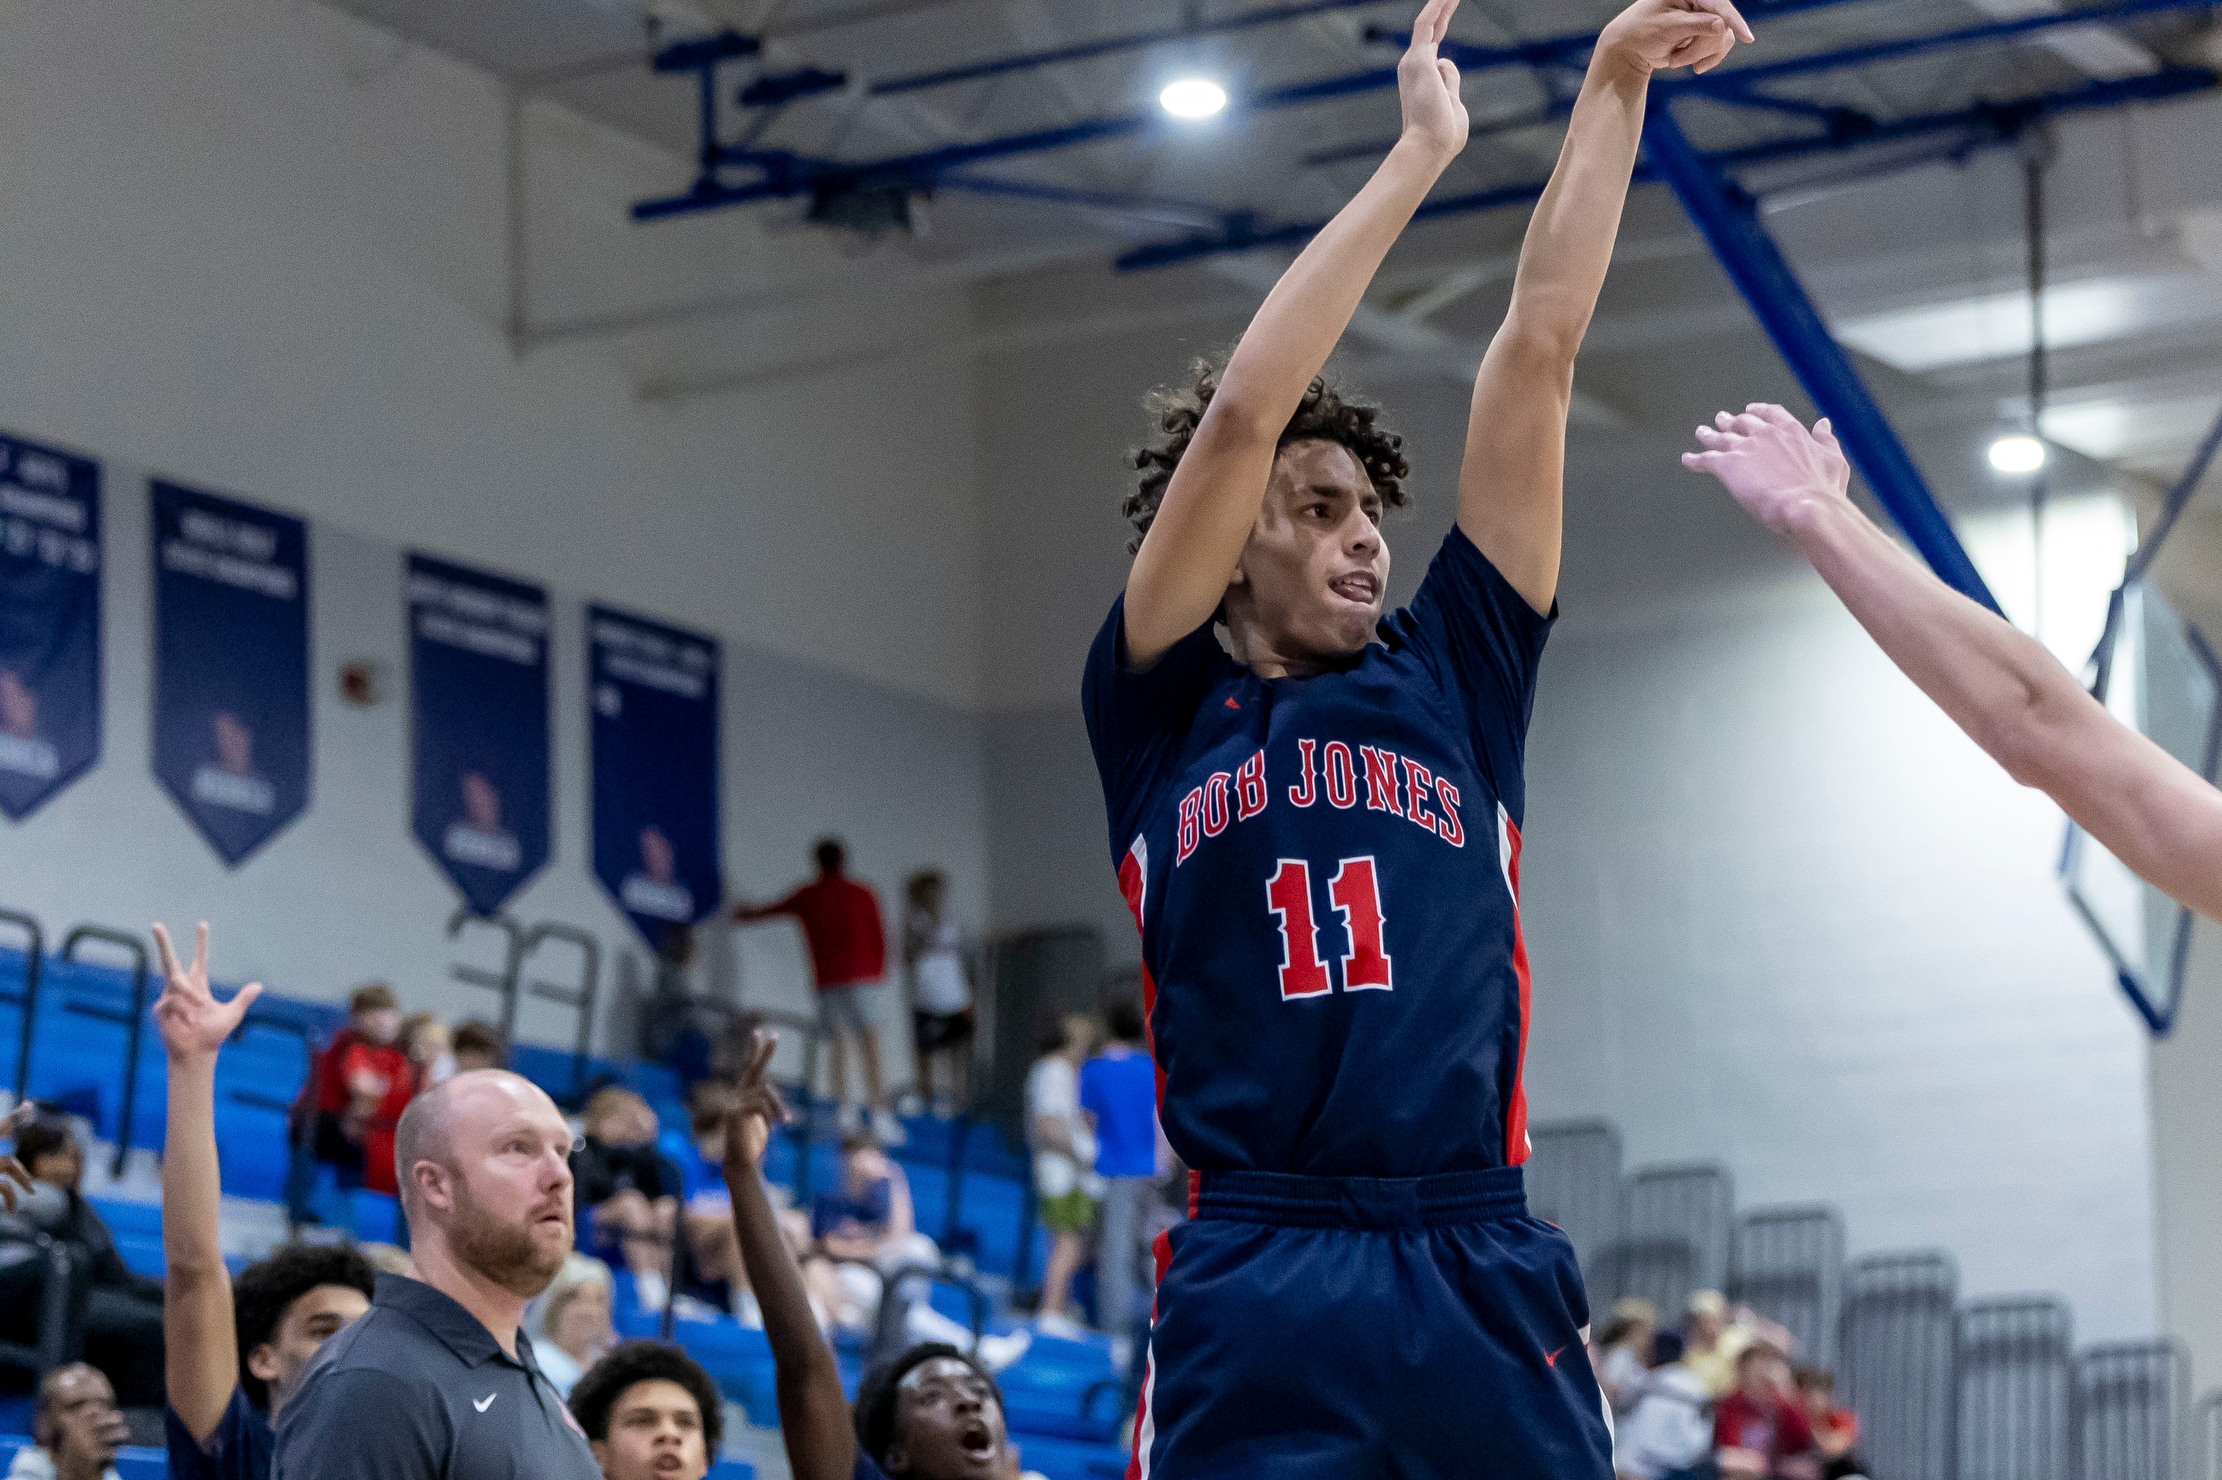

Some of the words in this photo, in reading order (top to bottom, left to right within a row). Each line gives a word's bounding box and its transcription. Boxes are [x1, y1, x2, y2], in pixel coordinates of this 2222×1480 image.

[1176, 749, 1268, 867] BOB
[1288, 738, 1465, 848] JONES
[1265, 855, 1394, 1002] 11
